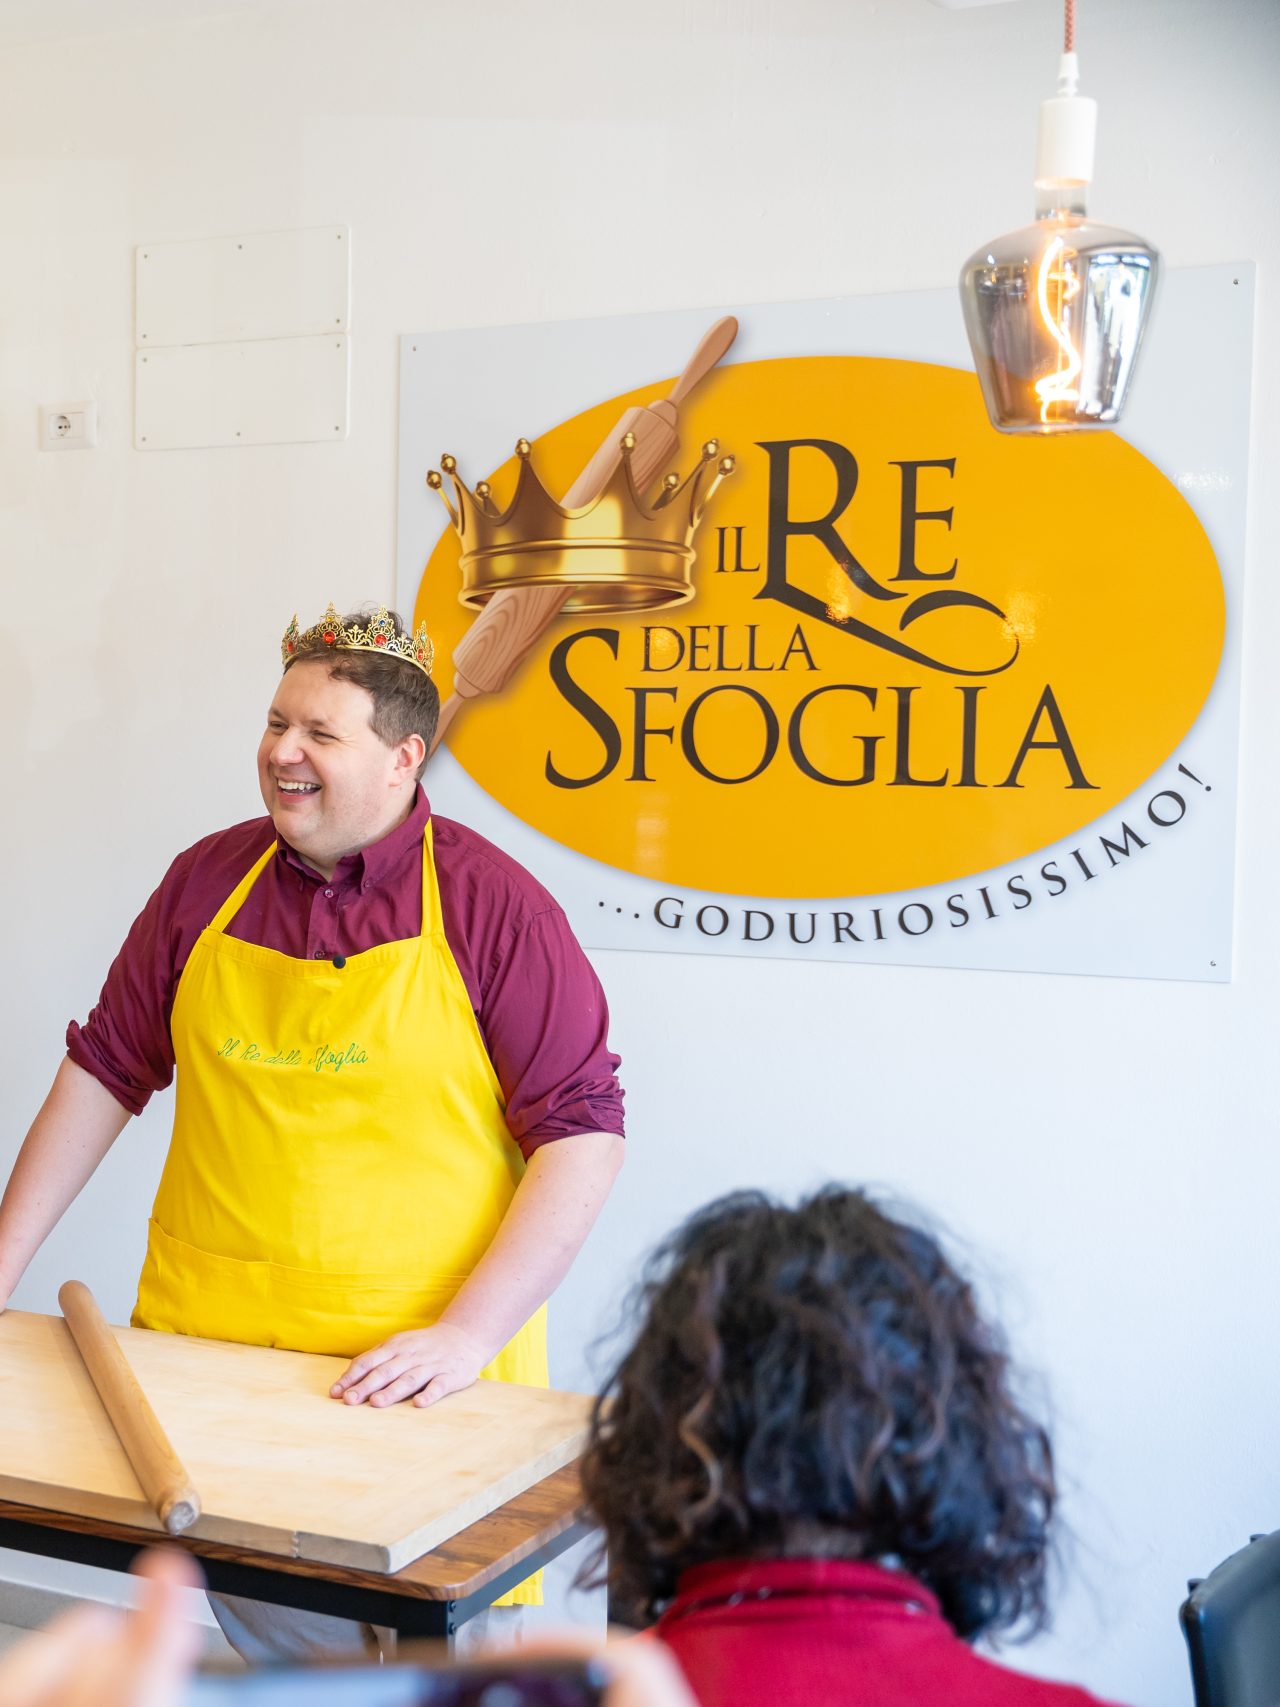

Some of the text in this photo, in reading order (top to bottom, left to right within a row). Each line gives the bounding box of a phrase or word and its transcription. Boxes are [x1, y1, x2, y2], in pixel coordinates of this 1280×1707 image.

[715, 438, 1020, 676] IL RE
[640, 623, 821, 672] DELLA
[545, 628, 1101, 791] SFOGLIA
[218, 1038, 240, 1056] Il
[240, 1044, 261, 1060] Re
